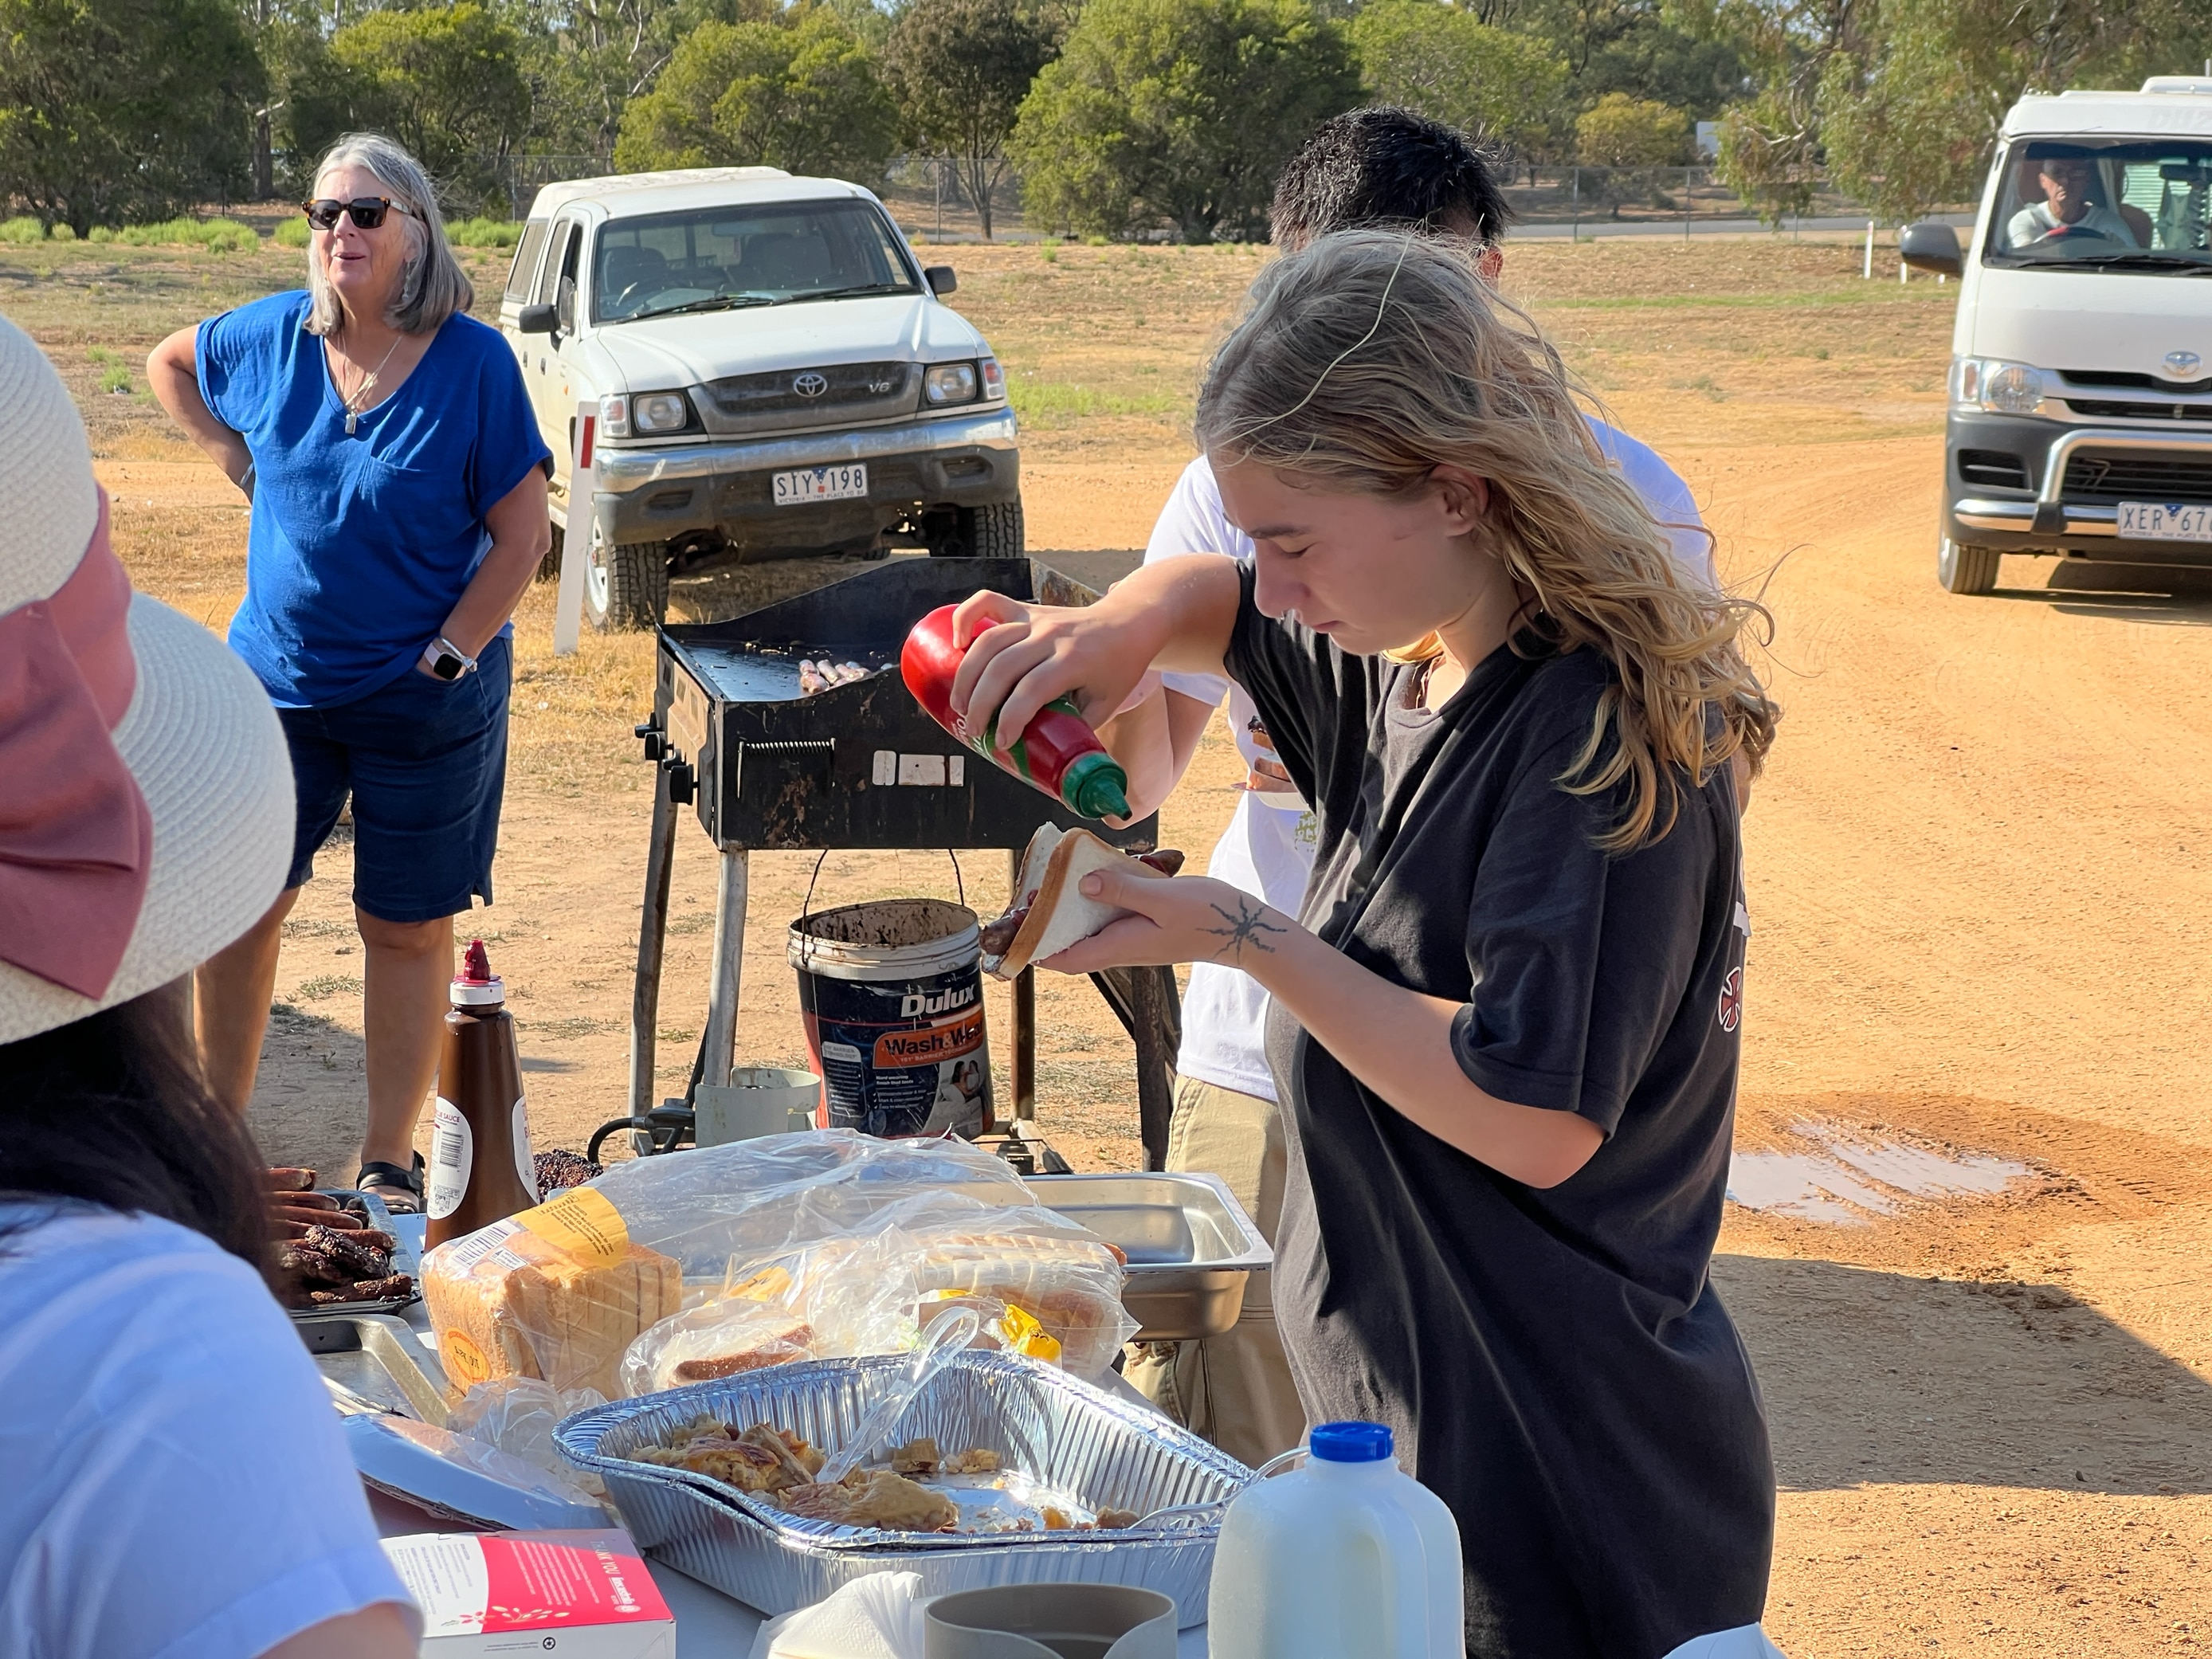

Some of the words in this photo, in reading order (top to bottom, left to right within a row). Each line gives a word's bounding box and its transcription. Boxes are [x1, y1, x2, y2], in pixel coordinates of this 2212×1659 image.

[869, 382, 890, 393] V6
[777, 473, 812, 496] SIY
[830, 469, 862, 491] 198
[2124, 507, 2163, 530] XER
[2182, 511, 2212, 531] 67
[900, 984, 975, 1018] Dulux
[443, 1113, 461, 1123] SAUCE
[590, 1541, 614, 1561] THANK
[601, 1562, 621, 1575] YOU
